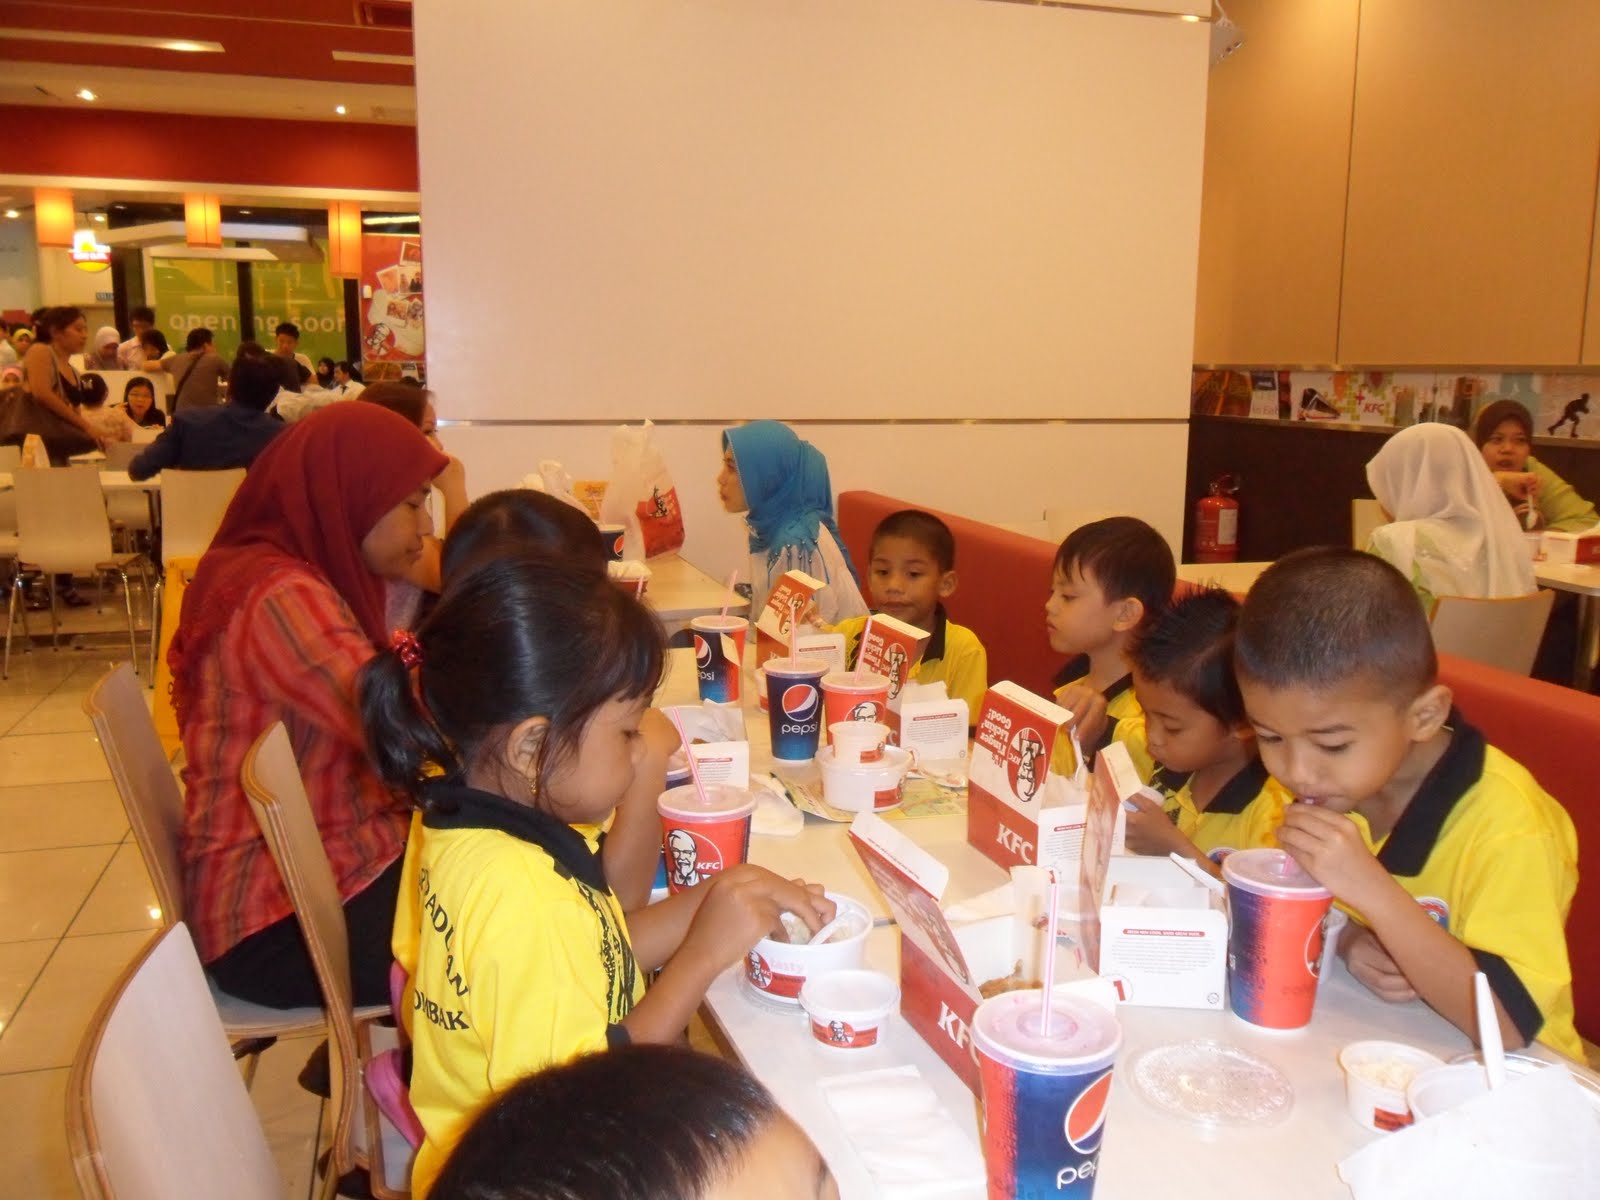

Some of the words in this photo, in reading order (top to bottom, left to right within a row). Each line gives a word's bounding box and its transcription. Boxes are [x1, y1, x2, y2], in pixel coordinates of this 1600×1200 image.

[169, 313, 280, 337] openng
[696, 671, 715, 681] psi
[781, 721, 818, 735] pepsi
[985, 708, 1012, 730] Good!
[996, 822, 1034, 865] KFC
[696, 862, 720, 870] KFC
